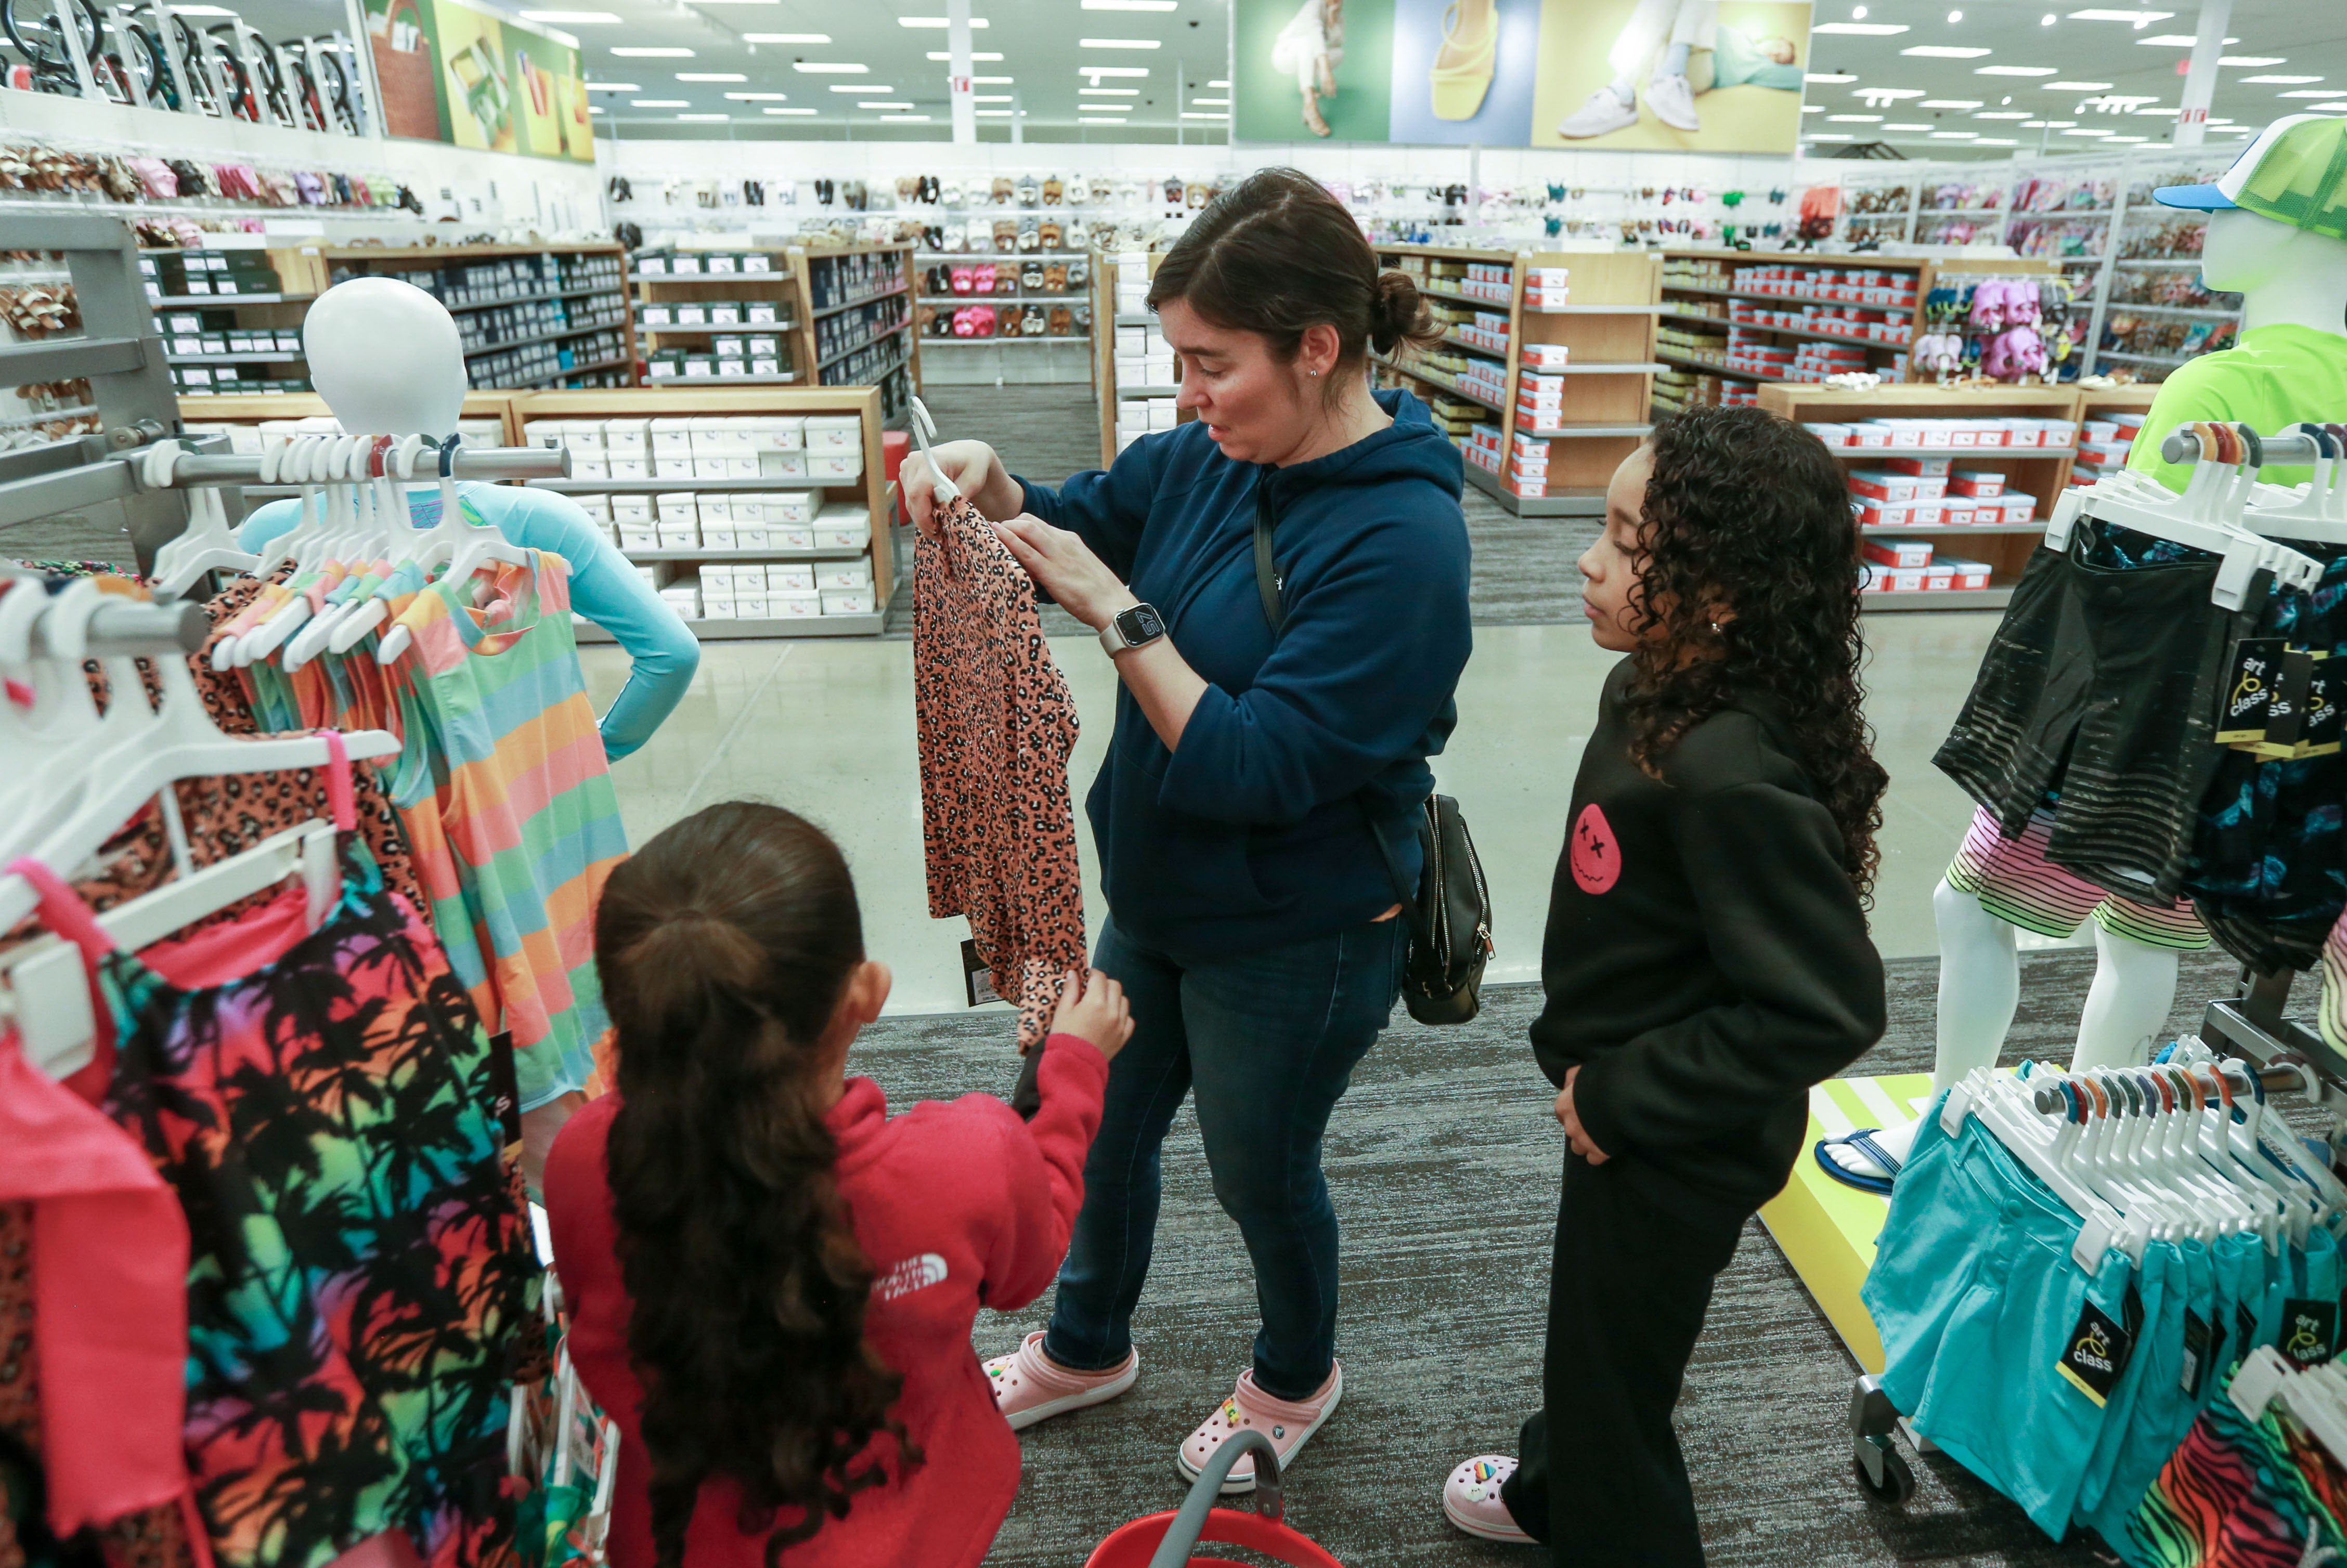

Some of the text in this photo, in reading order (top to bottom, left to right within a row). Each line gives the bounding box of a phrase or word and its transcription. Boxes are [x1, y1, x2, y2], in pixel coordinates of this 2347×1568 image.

[2243, 657, 2267, 676] art
[2311, 679, 2326, 695] rt
[2229, 688, 2268, 717] class
[2294, 1314, 2320, 1332] art
[2090, 1321, 2111, 1347] art
[2073, 1348, 2113, 1373] class
[2293, 1343, 2327, 1361] lass
